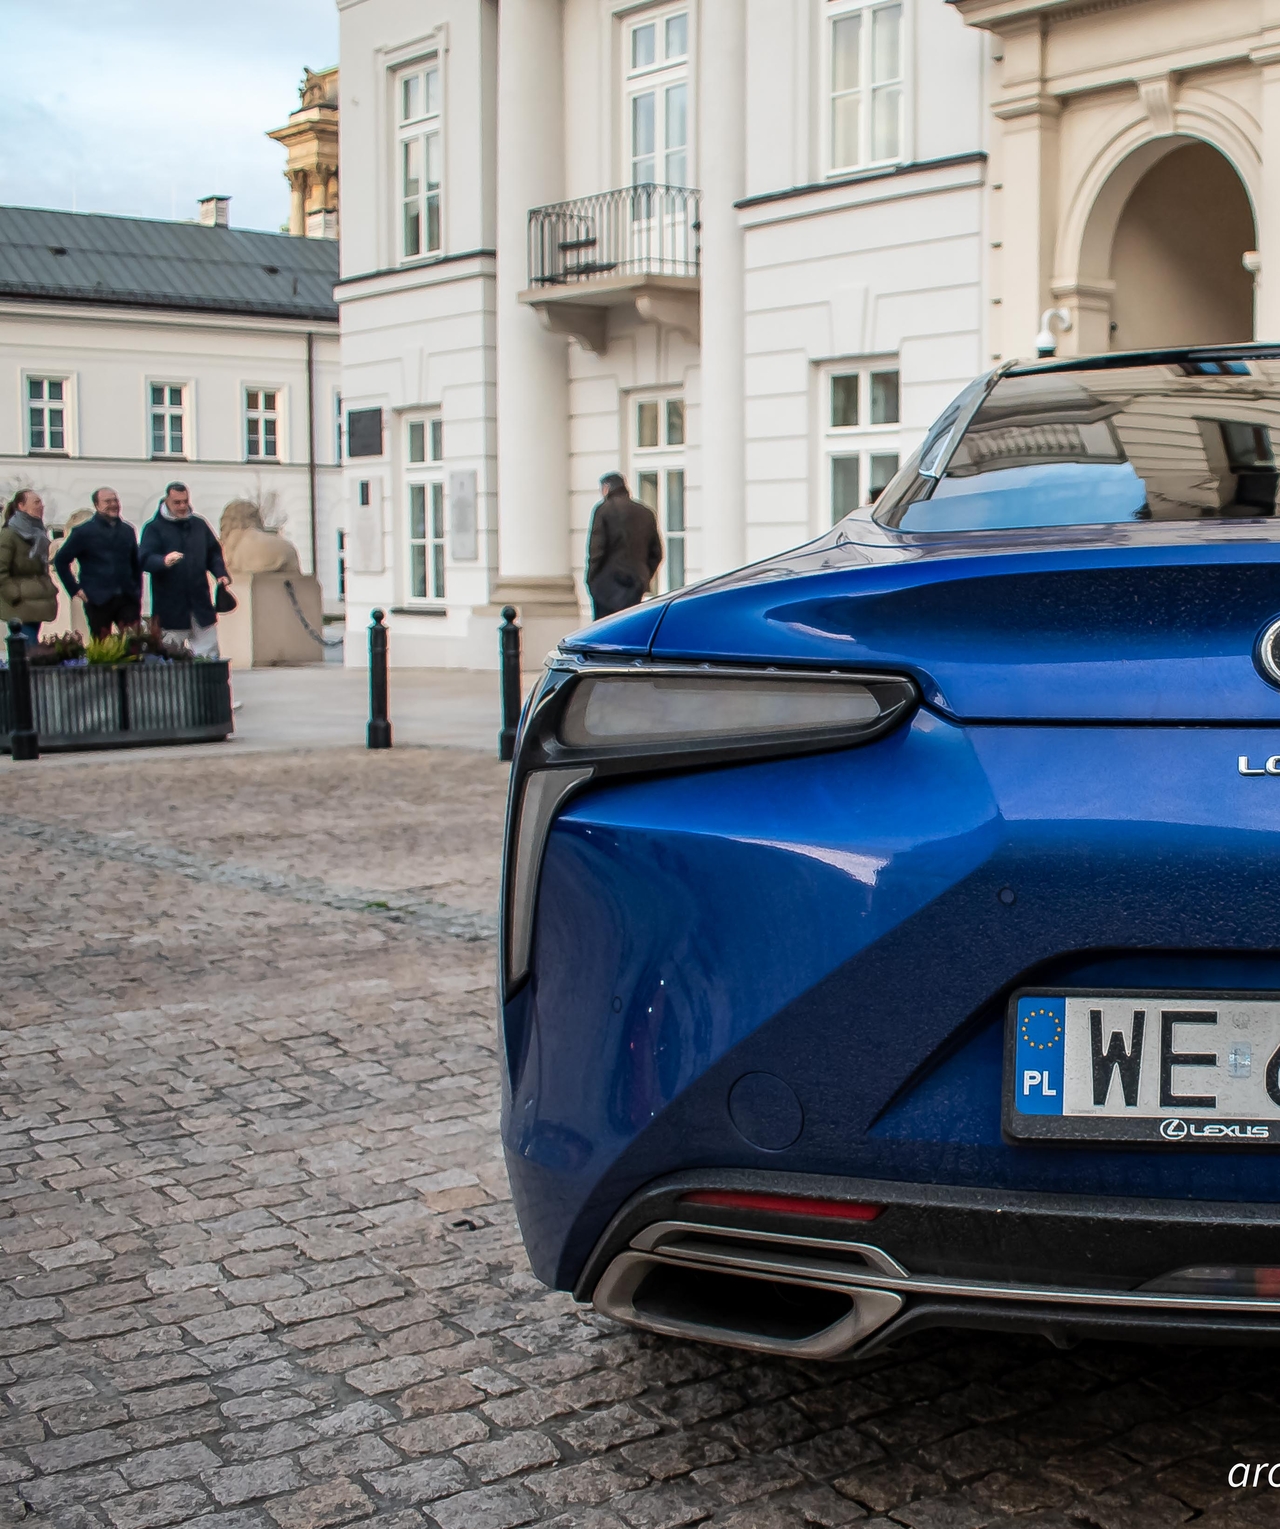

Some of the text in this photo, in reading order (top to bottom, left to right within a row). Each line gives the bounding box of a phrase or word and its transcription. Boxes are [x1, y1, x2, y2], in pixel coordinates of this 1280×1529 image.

[1090, 1009, 1218, 1108] WE
[1023, 1070, 1057, 1096] PL
[1189, 1124, 1269, 1138] LEXUS
